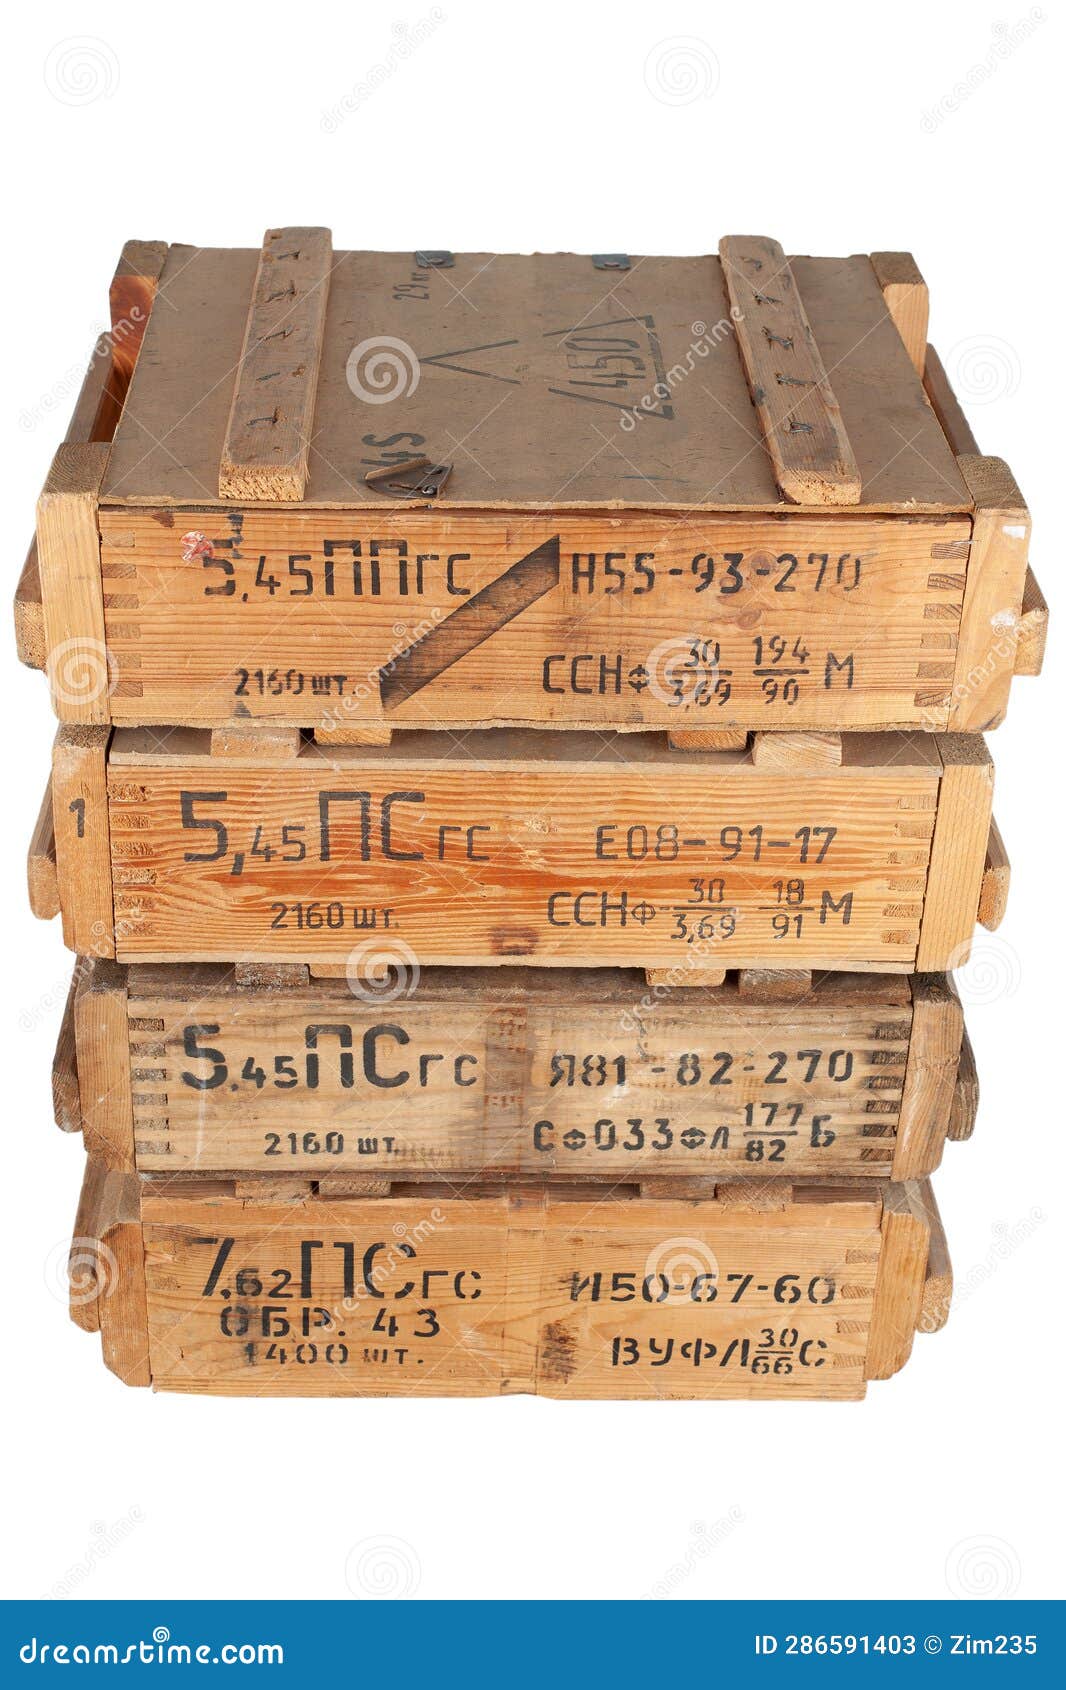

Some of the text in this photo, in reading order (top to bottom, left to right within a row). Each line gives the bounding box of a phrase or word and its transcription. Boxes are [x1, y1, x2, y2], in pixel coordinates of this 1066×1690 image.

[565, 337, 646, 388] 450
[753, 636, 810, 666] 194
[761, 679, 800, 706] 90
[69, 798, 86, 837] 1
[688, 878, 805, 905] 30 18
[270, 902, 345, 930] 2160
[670, 914, 803, 943] 3,69 91
[743, 1103, 804, 1127] 177
[264, 1132, 344, 1156] 2160
[745, 1140, 786, 1162] 82
[758, 1328, 799, 1348] 30
[751, 1355, 794, 1375] 66
